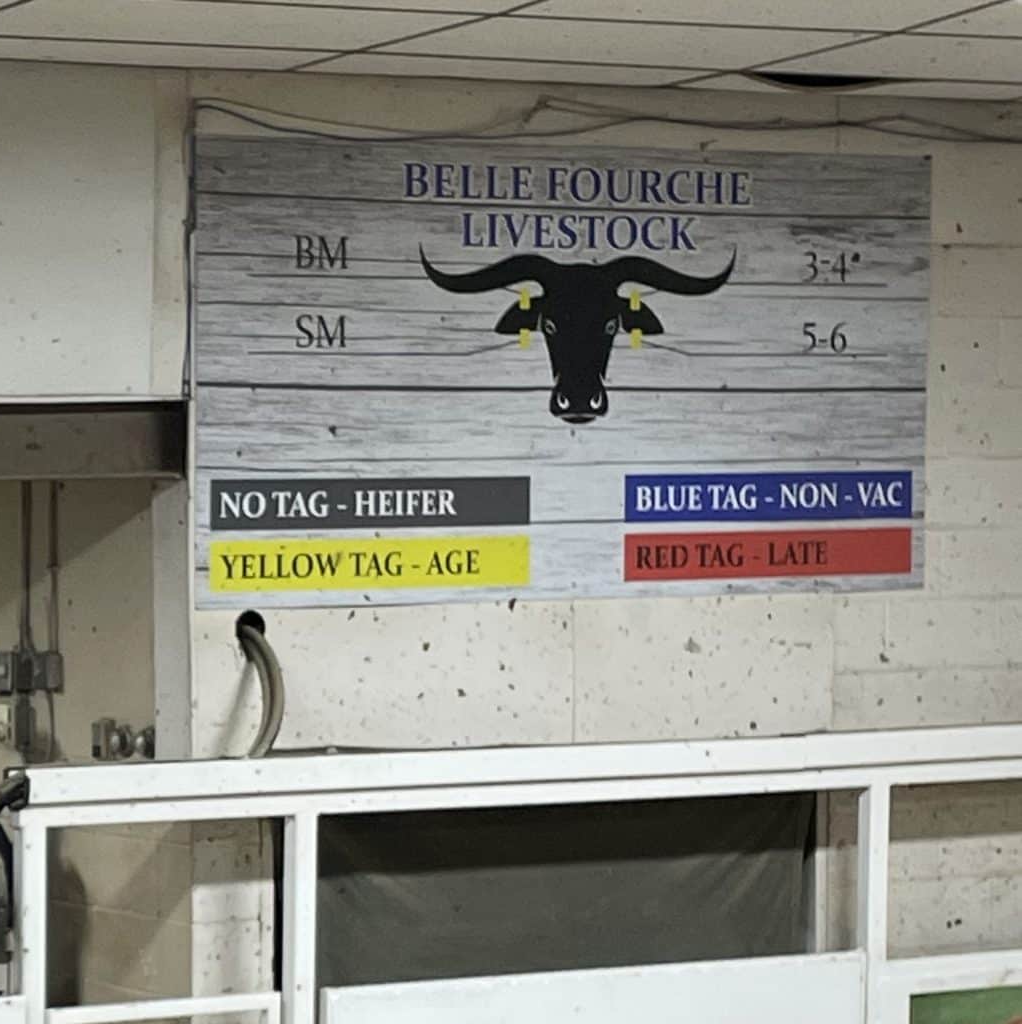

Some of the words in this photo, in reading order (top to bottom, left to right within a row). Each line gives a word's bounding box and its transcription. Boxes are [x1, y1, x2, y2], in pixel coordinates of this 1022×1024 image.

[403, 162, 532, 199] BELLE
[546, 166, 751, 206] FOURCHE
[461, 212, 698, 251] LIVESTOCK
[293, 233, 349, 269] BM
[295, 313, 347, 349] SM
[802, 322, 848, 353] 5-6
[219, 491, 266, 519] NO
[272, 490, 329, 518] TAG
[354, 488, 457, 517] HEIFER
[636, 485, 702, 512] BLUE
[707, 484, 757, 510] TAG
[780, 482, 838, 508] NON
[857, 481, 903, 507] VAC
[221, 552, 342, 579] YELLOW
[349, 551, 403, 577] TAG
[426, 550, 480, 575] AGE
[636, 545, 688, 569] RED
[695, 543, 744, 568] TAG
[768, 540, 828, 566] LATE
